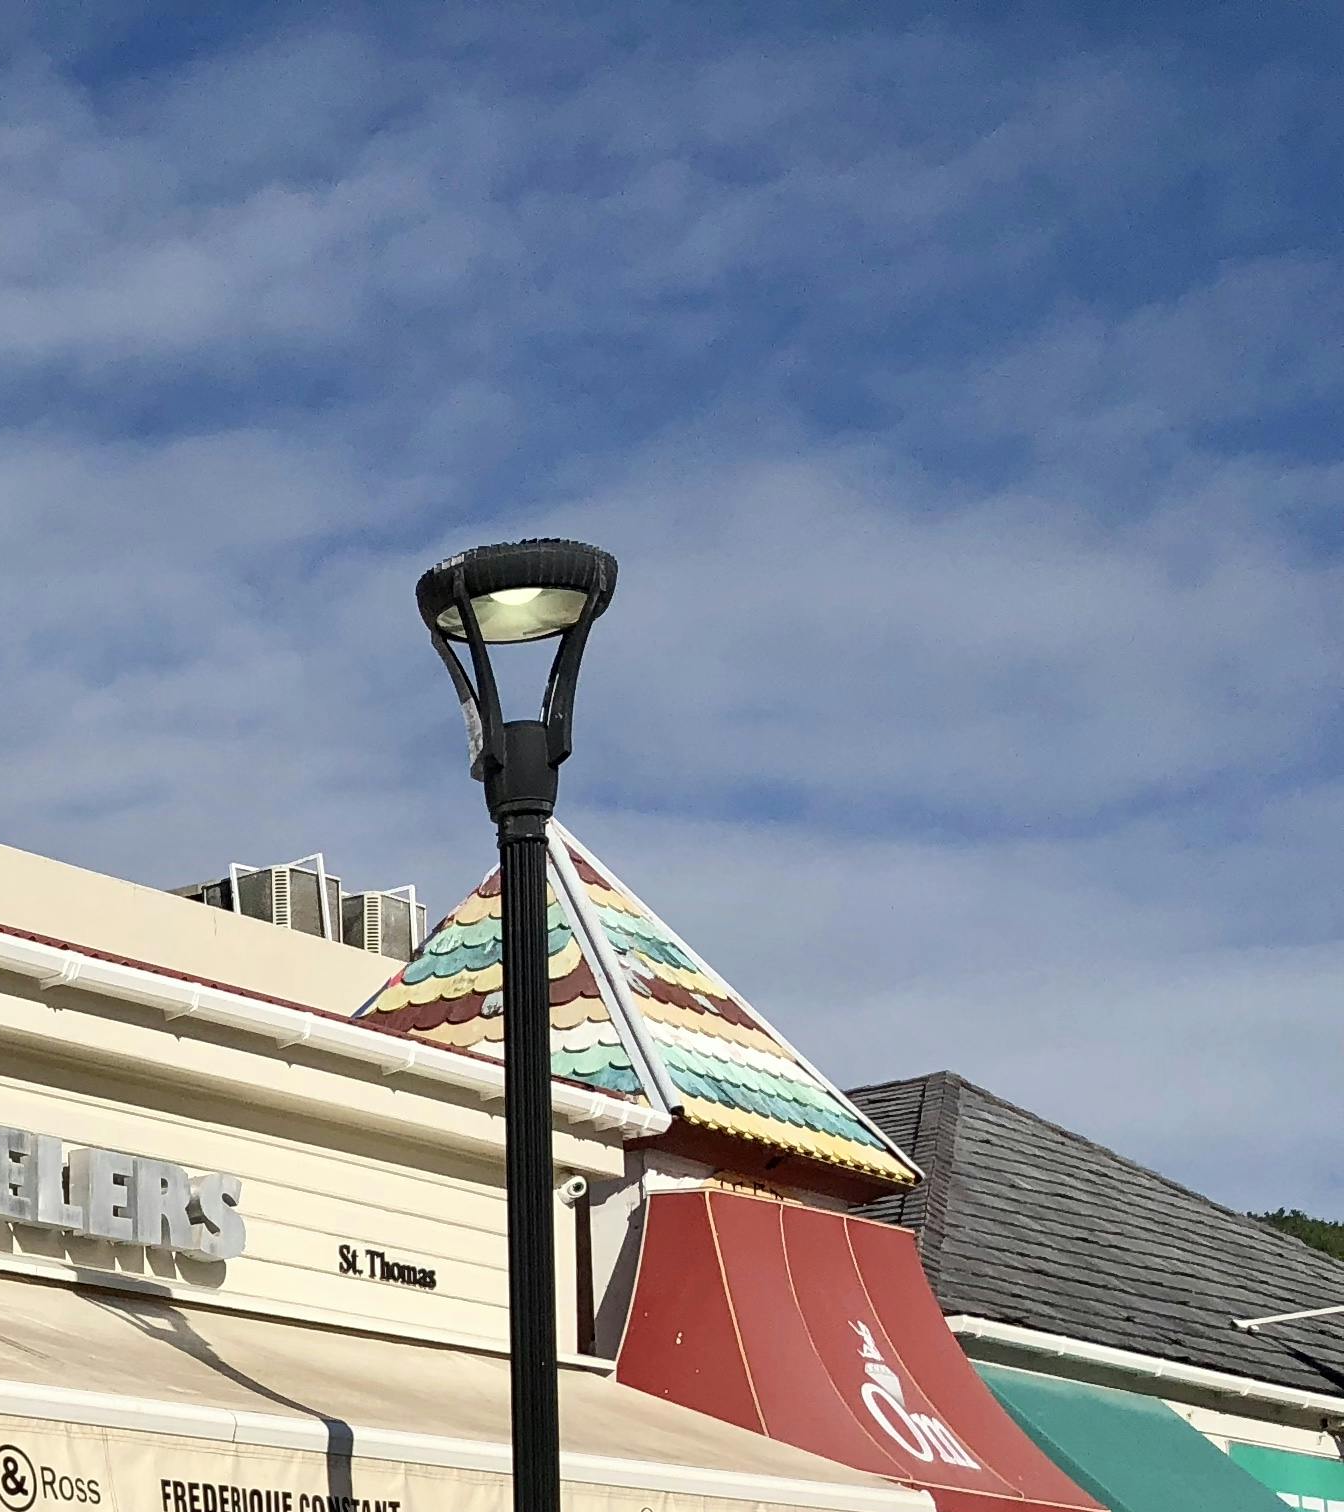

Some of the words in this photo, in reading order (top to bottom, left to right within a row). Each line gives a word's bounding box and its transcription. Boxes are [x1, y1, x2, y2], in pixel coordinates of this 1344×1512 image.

[338, 1244, 364, 1277] St.
[365, 1249, 437, 1291] Thomas
[861, 1382, 982, 1472] Om
